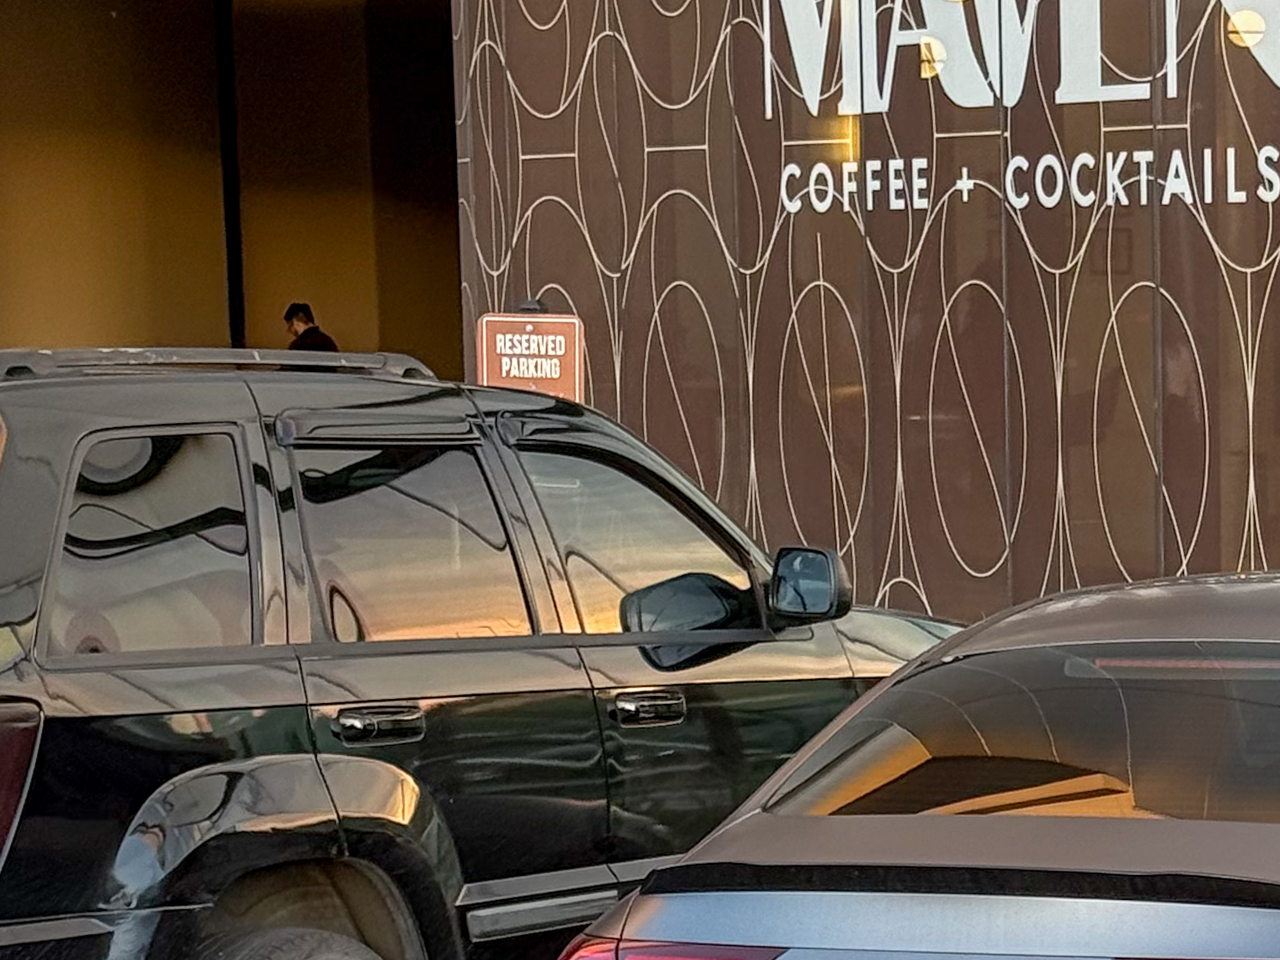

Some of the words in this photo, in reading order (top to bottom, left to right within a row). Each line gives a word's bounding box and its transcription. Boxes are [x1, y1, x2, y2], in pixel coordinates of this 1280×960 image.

[780, 158, 929, 213] COFFEE
[956, 168, 974, 202] +
[496, 334, 566, 355] RESERVED
[501, 357, 561, 378] PARKING
